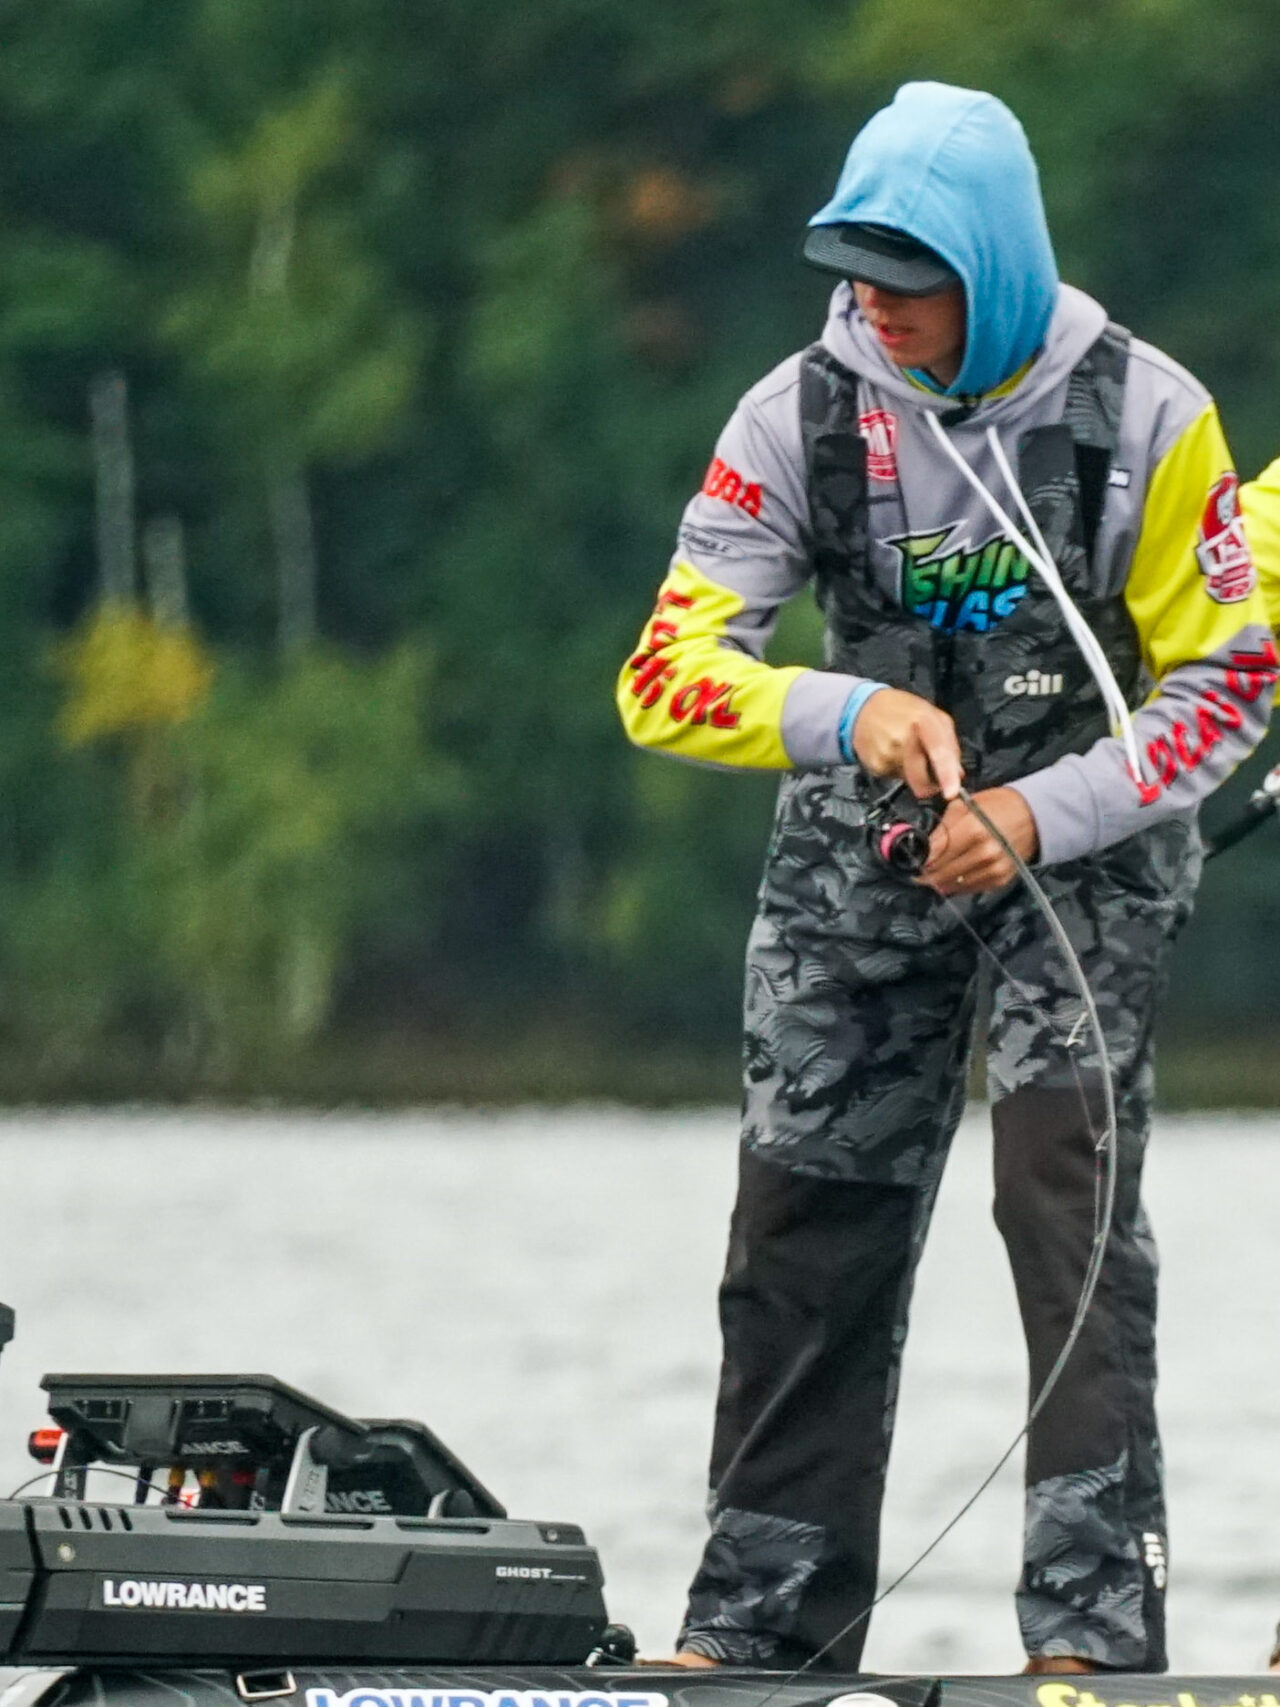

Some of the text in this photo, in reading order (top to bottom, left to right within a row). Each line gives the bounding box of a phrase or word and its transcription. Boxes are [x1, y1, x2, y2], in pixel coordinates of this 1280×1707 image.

[1003, 669, 1063, 697] Gill
[495, 1566, 553, 1579] GHOST
[102, 1579, 267, 1612] LOWRANCE
